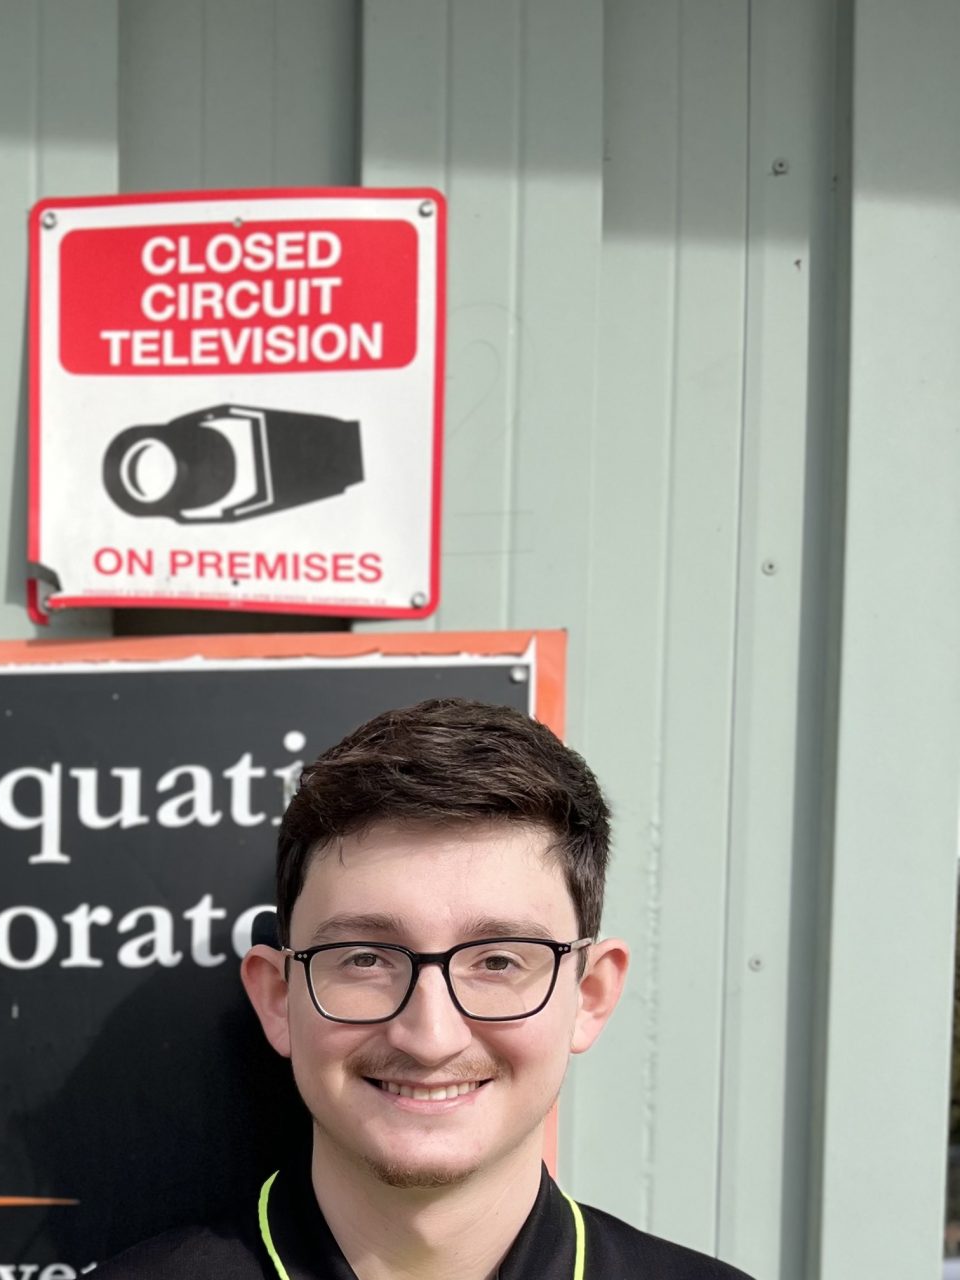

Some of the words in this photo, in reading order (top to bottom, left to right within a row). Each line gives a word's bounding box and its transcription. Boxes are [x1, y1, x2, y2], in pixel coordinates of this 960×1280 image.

[141, 231, 342, 275] CLOSED
[141, 277, 342, 322] CIRCUIT
[100, 322, 383, 367] TELEVISION
[93, 547, 154, 577] ON
[169, 550, 384, 583] PREMISES
